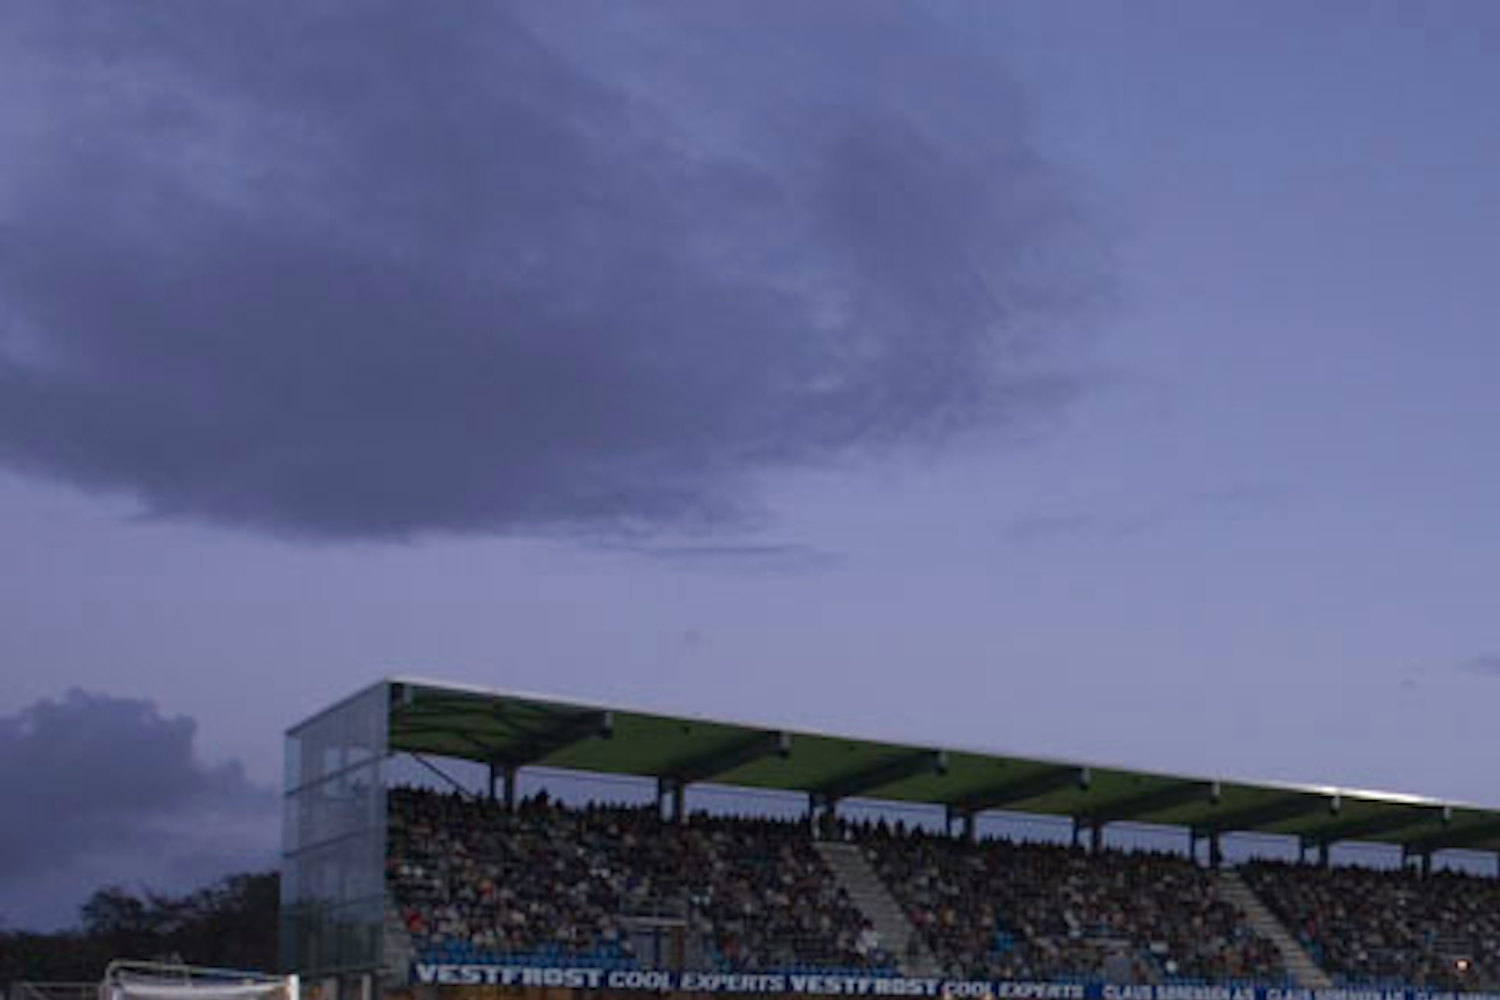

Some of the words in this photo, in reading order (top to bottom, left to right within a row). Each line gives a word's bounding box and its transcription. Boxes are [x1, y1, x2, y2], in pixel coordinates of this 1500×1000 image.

[416, 964, 603, 988] VESTFROST
[608, 970, 674, 990] COOL
[680, 973, 785, 993] EXPERTS
[789, 974, 939, 996] VESTFROST
